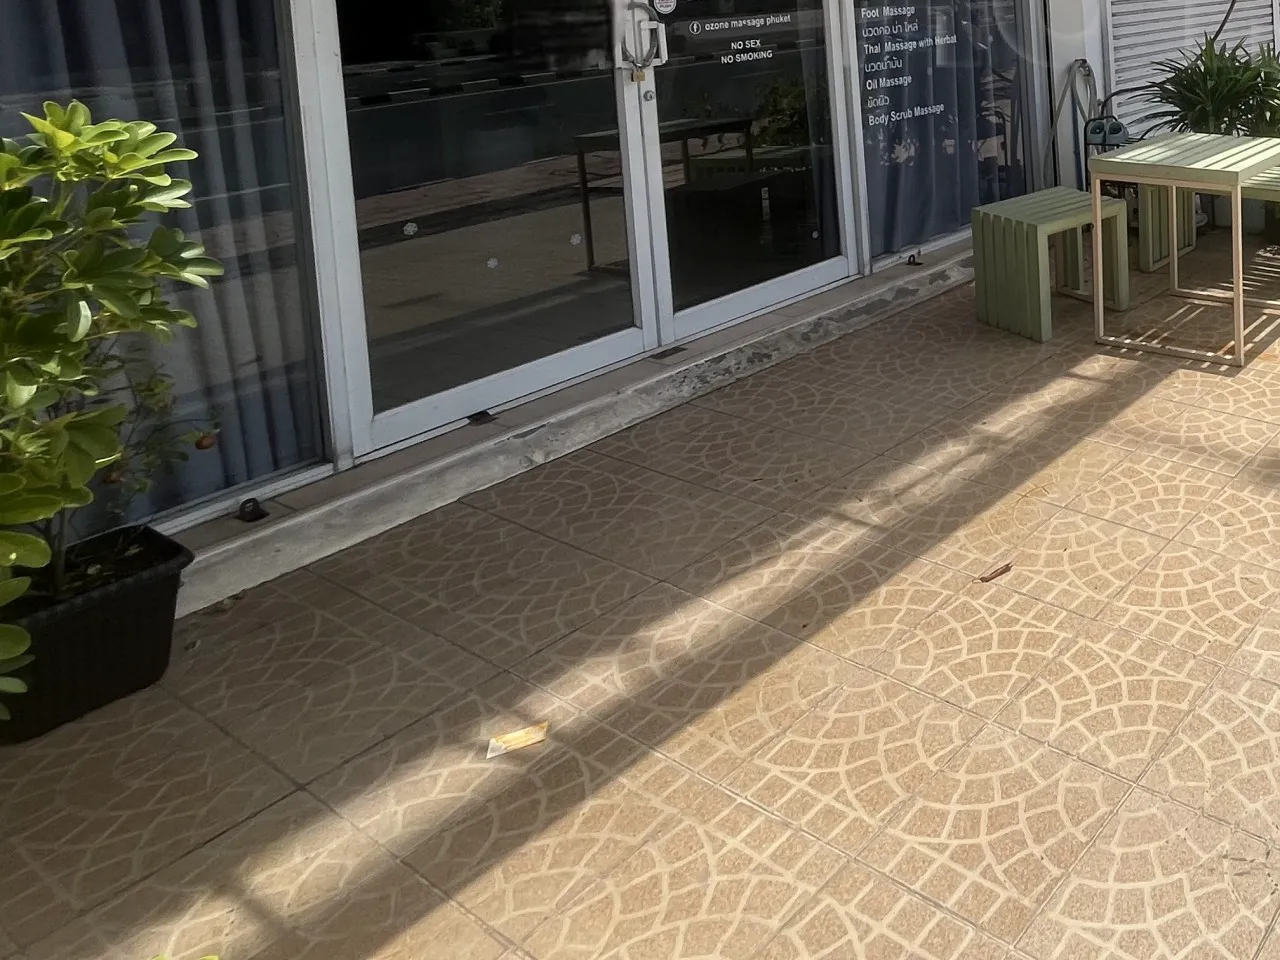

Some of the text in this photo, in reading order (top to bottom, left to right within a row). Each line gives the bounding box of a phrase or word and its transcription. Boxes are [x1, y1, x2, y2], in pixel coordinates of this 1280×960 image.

[861, 6, 916, 18] Foot Massage
[704, 21, 729, 31] ozone
[766, 14, 792, 26] phuket
[731, 39, 761, 50] NO SEX
[864, 43, 881, 55] Thai
[884, 40, 917, 52] Massage
[918, 36, 933, 48] with
[721, 50, 773, 64] NO SMOKING
[866, 75, 912, 90] Oil Massage
[868, 103, 945, 126] Body Scrub Massage
